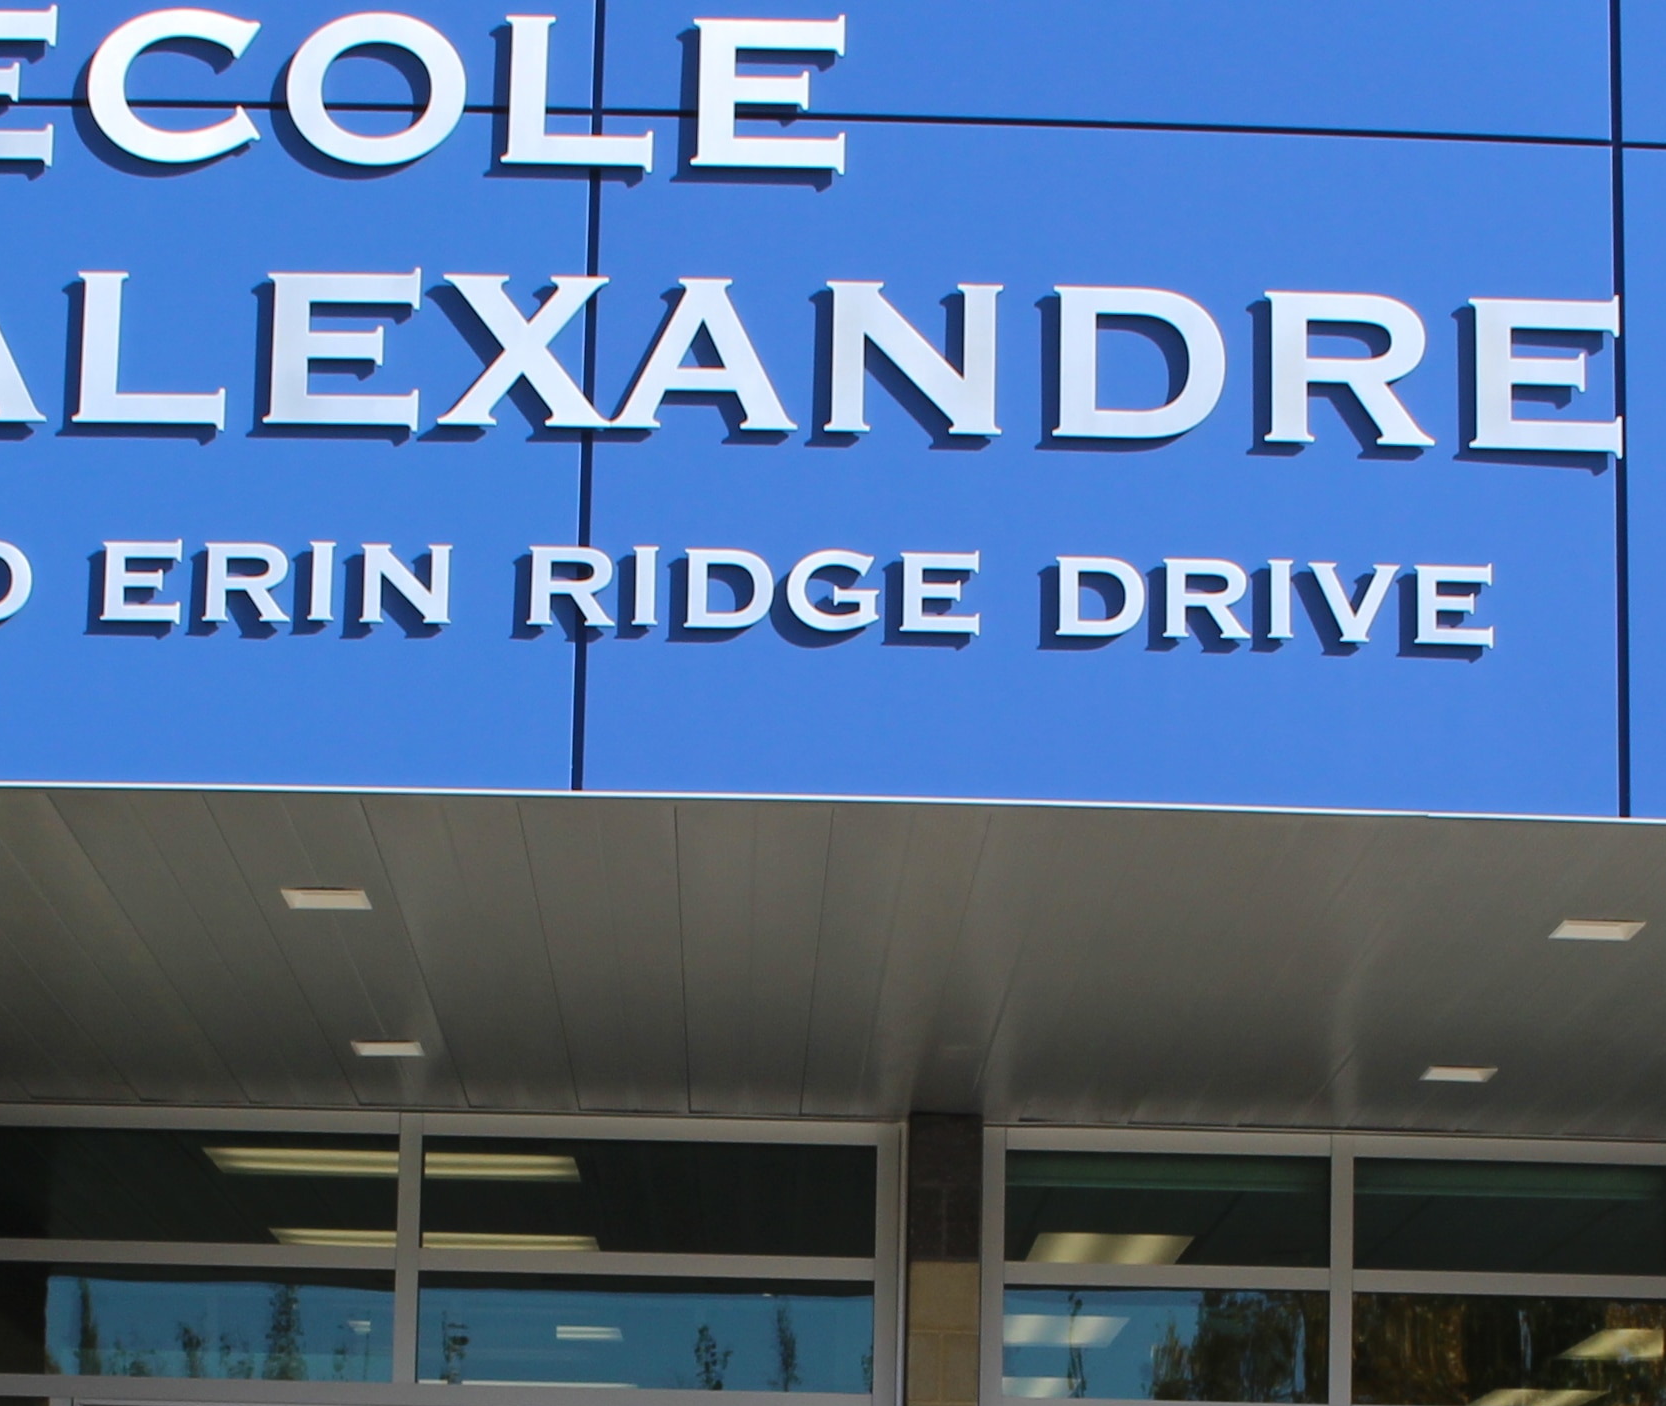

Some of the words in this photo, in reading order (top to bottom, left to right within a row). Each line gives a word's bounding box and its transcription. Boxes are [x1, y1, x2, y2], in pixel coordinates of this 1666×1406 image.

[99, 539, 453, 625] ERIN
[526, 544, 981, 636] RIDGE
[1054, 555, 1496, 650] DRIVE
